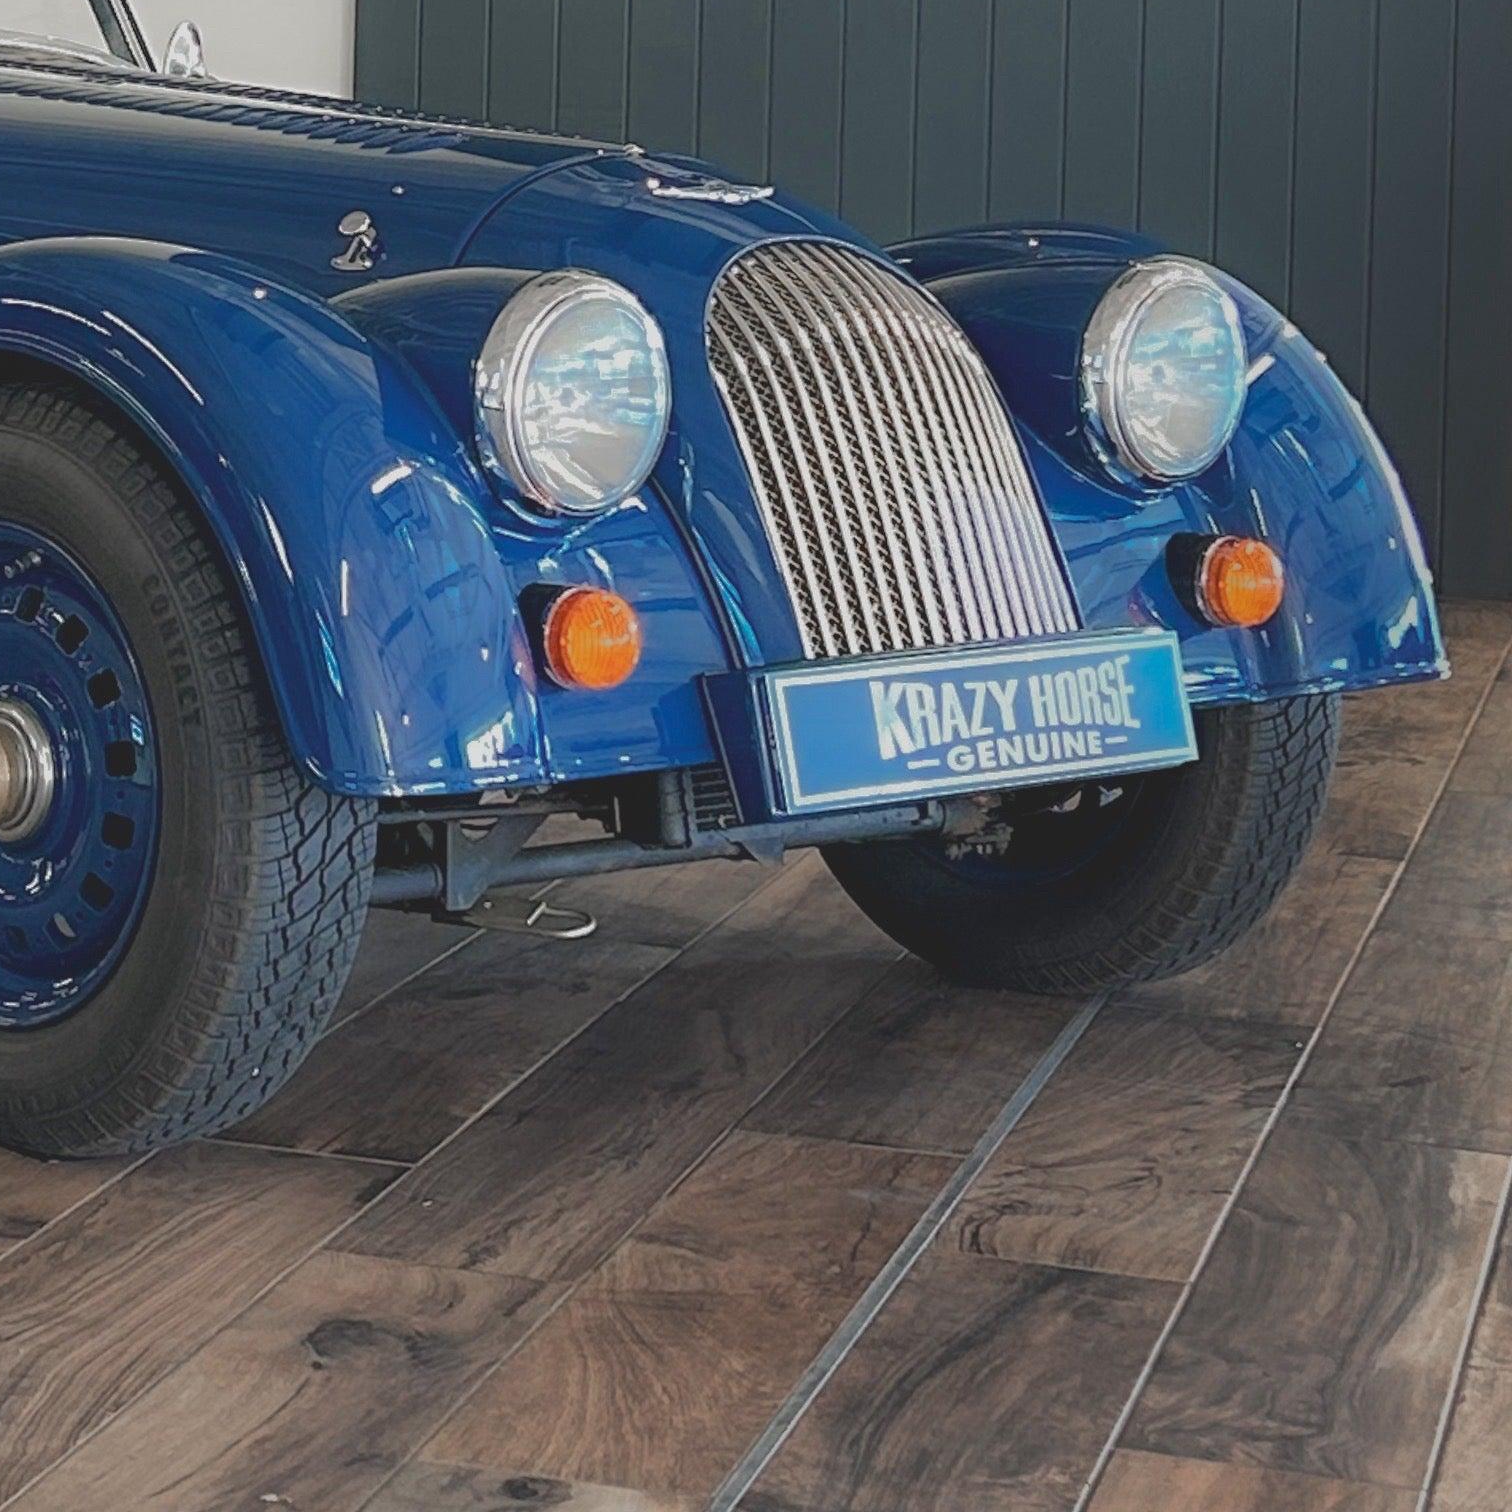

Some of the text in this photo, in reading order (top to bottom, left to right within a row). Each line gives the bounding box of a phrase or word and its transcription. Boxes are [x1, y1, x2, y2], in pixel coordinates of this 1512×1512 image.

[869, 654, 1141, 760] KRAZY HORSE
[946, 731, 1103, 772] GENUINE
